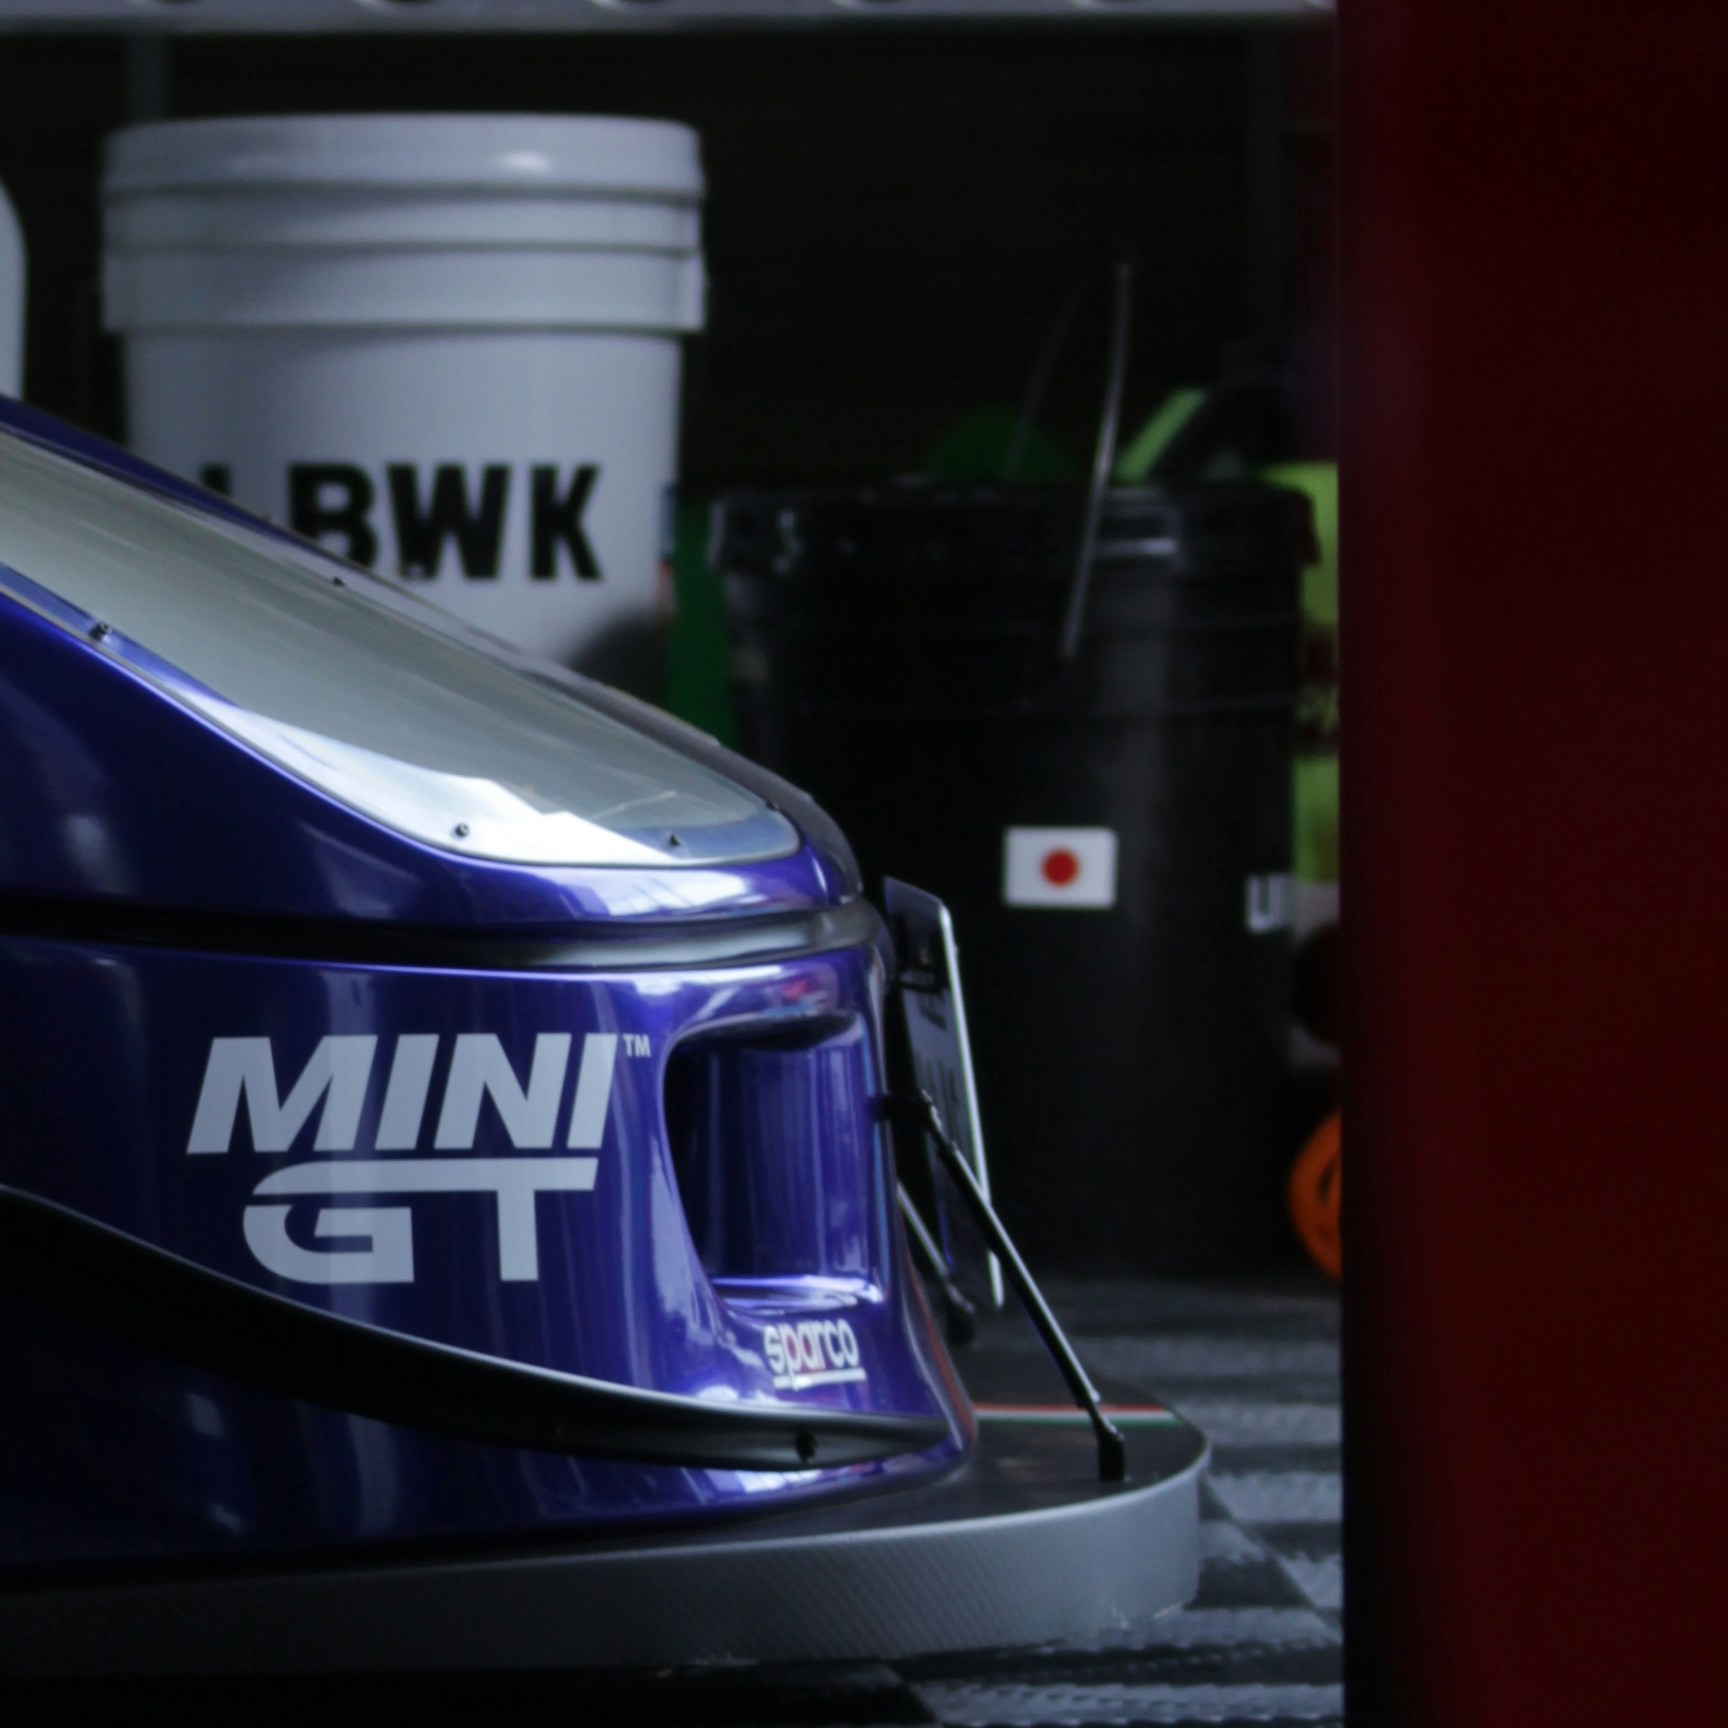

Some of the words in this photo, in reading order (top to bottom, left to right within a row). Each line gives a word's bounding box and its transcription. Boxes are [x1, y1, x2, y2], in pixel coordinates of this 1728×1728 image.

[202, 462, 604, 580] BWK
[185, 1032, 618, 1154] MINI
[242, 1157, 599, 1285] GT
[763, 1317, 862, 1391] sparco
